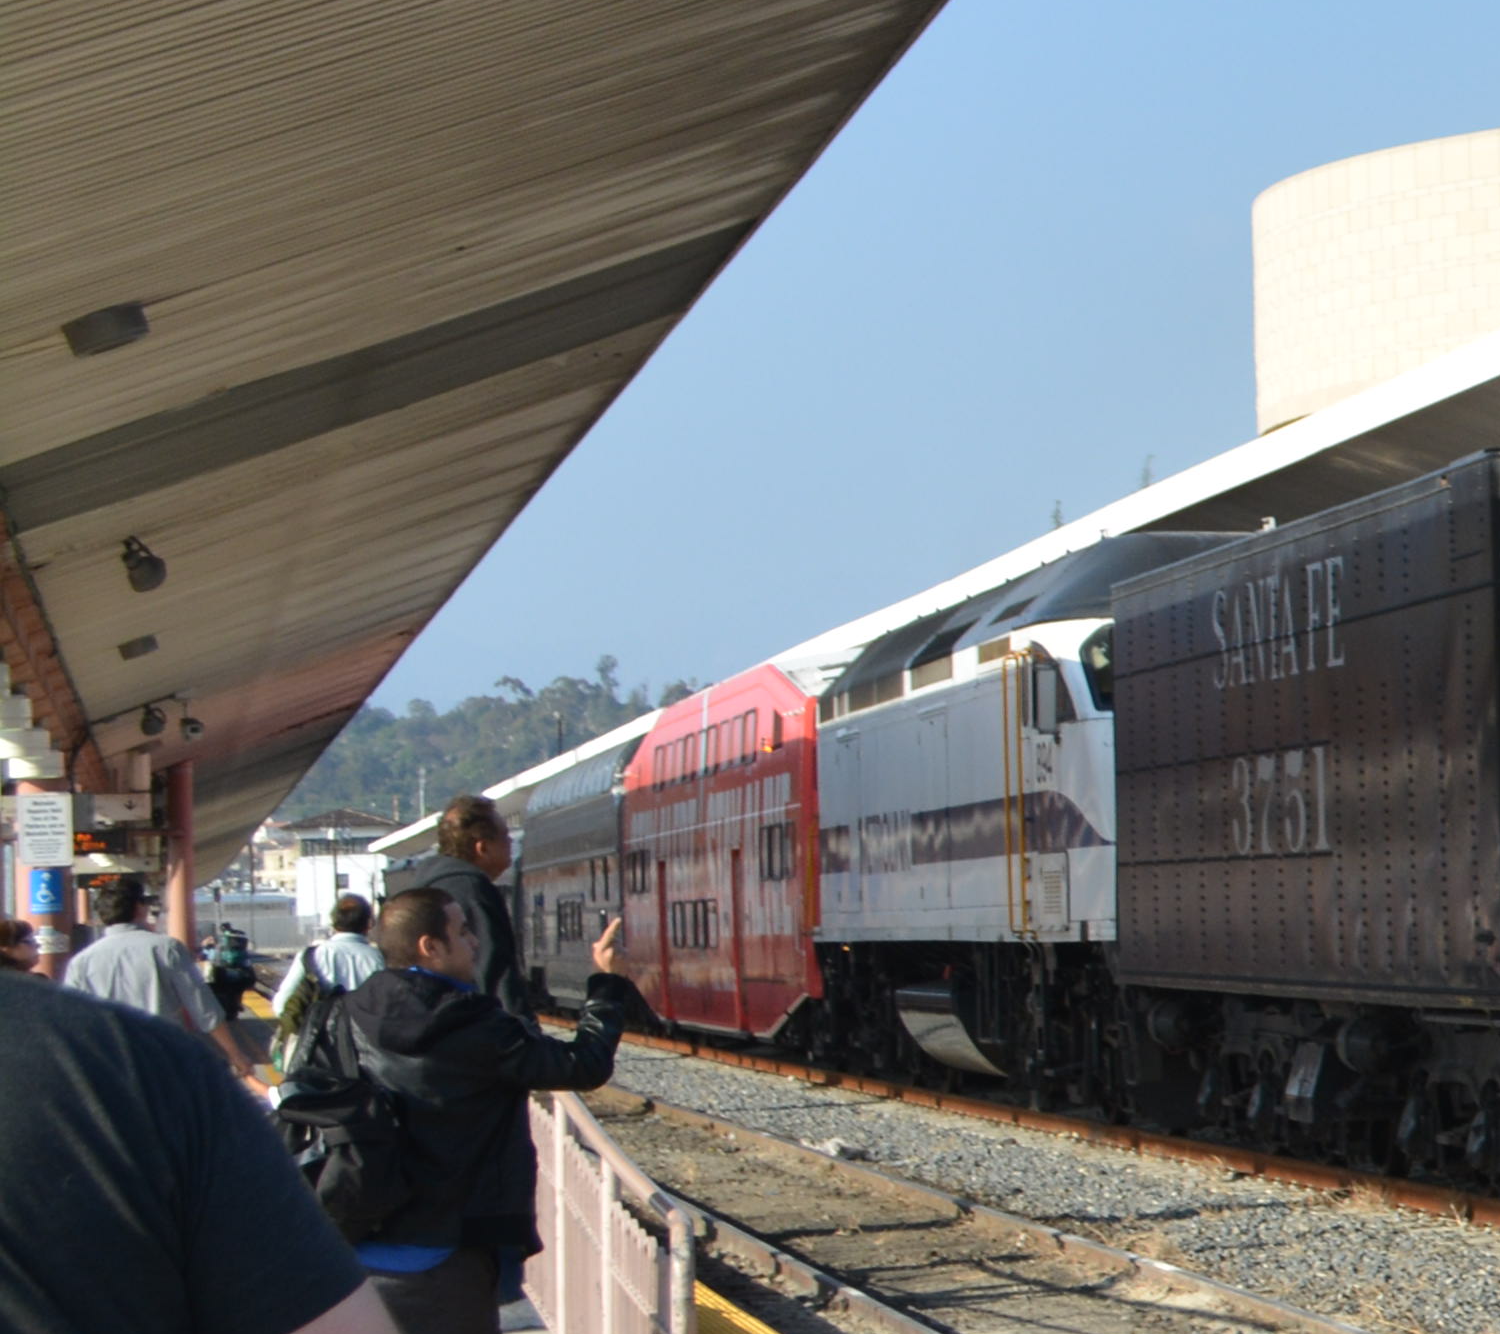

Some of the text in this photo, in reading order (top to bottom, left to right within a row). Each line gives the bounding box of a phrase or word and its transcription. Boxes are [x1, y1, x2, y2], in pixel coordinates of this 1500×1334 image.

[1212, 556, 1346, 690] SANTA FE
[1232, 746, 1331, 855] 3751
